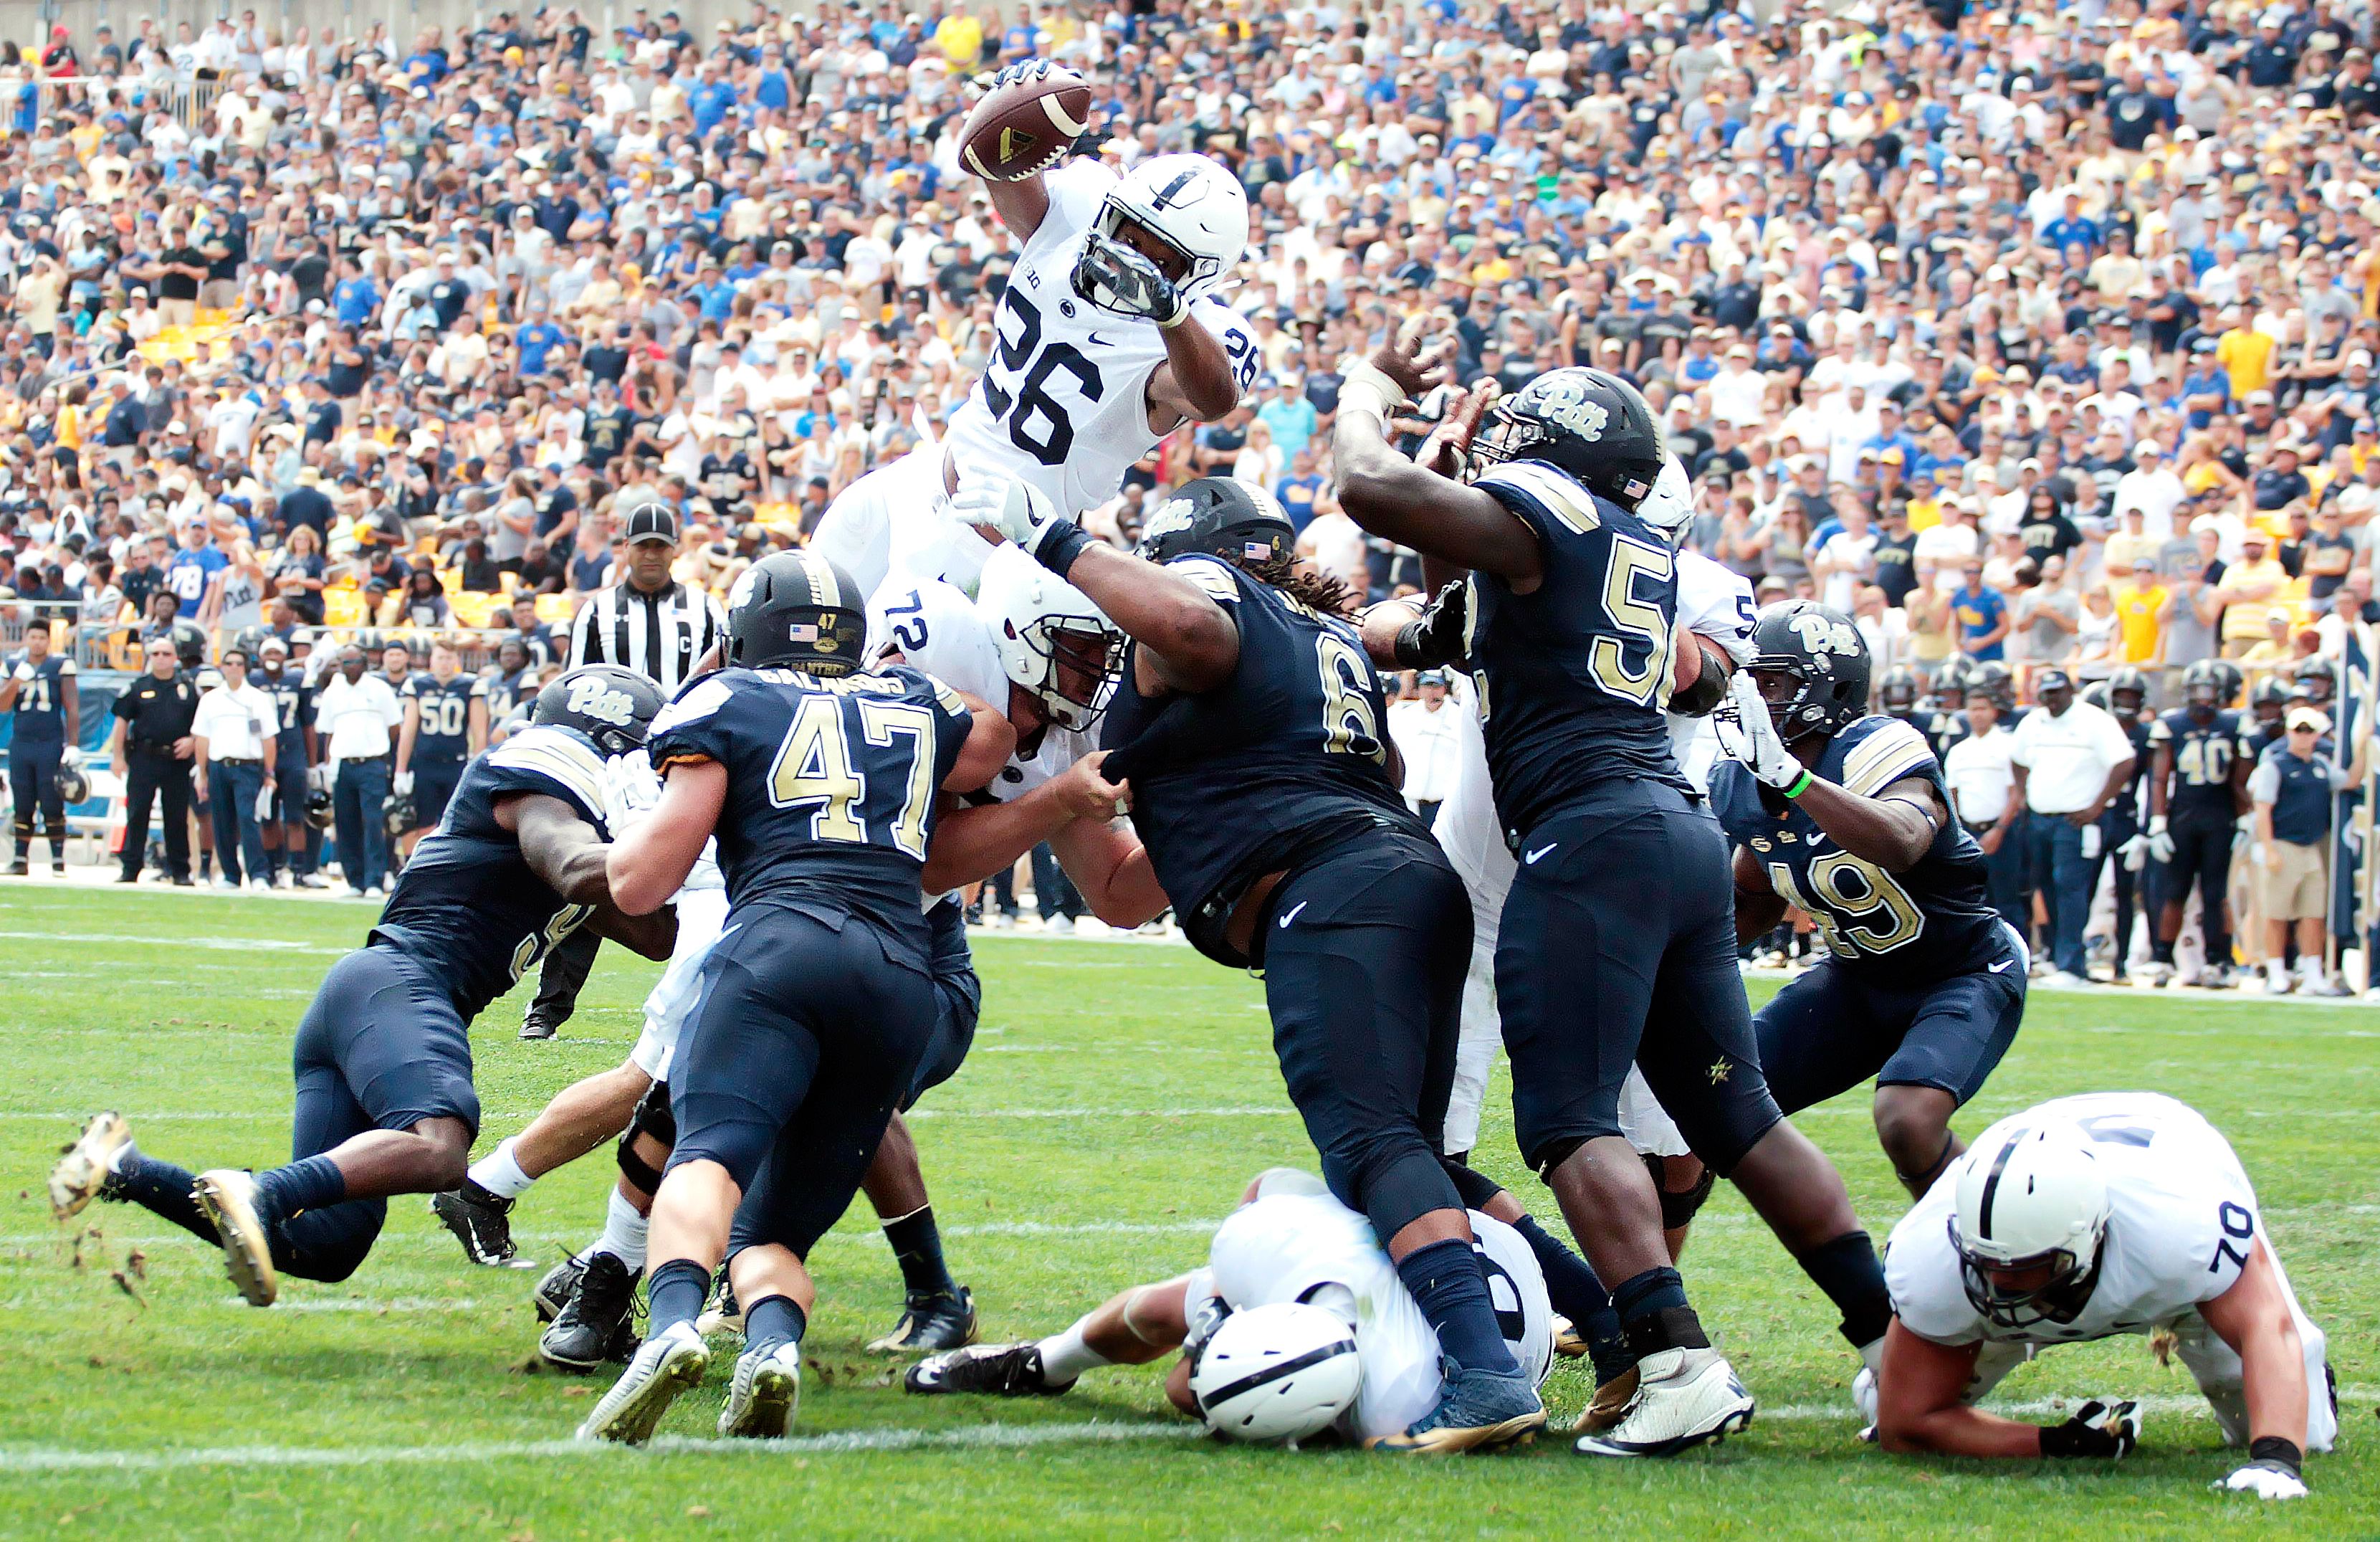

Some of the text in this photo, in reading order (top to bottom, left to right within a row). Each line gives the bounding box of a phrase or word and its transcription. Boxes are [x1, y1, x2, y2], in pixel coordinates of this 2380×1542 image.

[983, 285, 1104, 466] 26
[1225, 328, 1257, 392] 26
[1538, 380, 1610, 442] Pitt
[171, 564, 205, 600] 78
[679, 636, 692, 653] C
[818, 612, 838, 631] 47
[884, 589, 929, 652] 72
[1587, 532, 1679, 715] 5
[1788, 614, 1861, 657] Pitt
[18, 679, 52, 712] 71
[419, 696, 466, 737] 50
[565, 675, 634, 727] Pitt
[767, 693, 937, 862] 47
[2176, 738, 2233, 786] 40
[2208, 1200, 2254, 1274] 70
